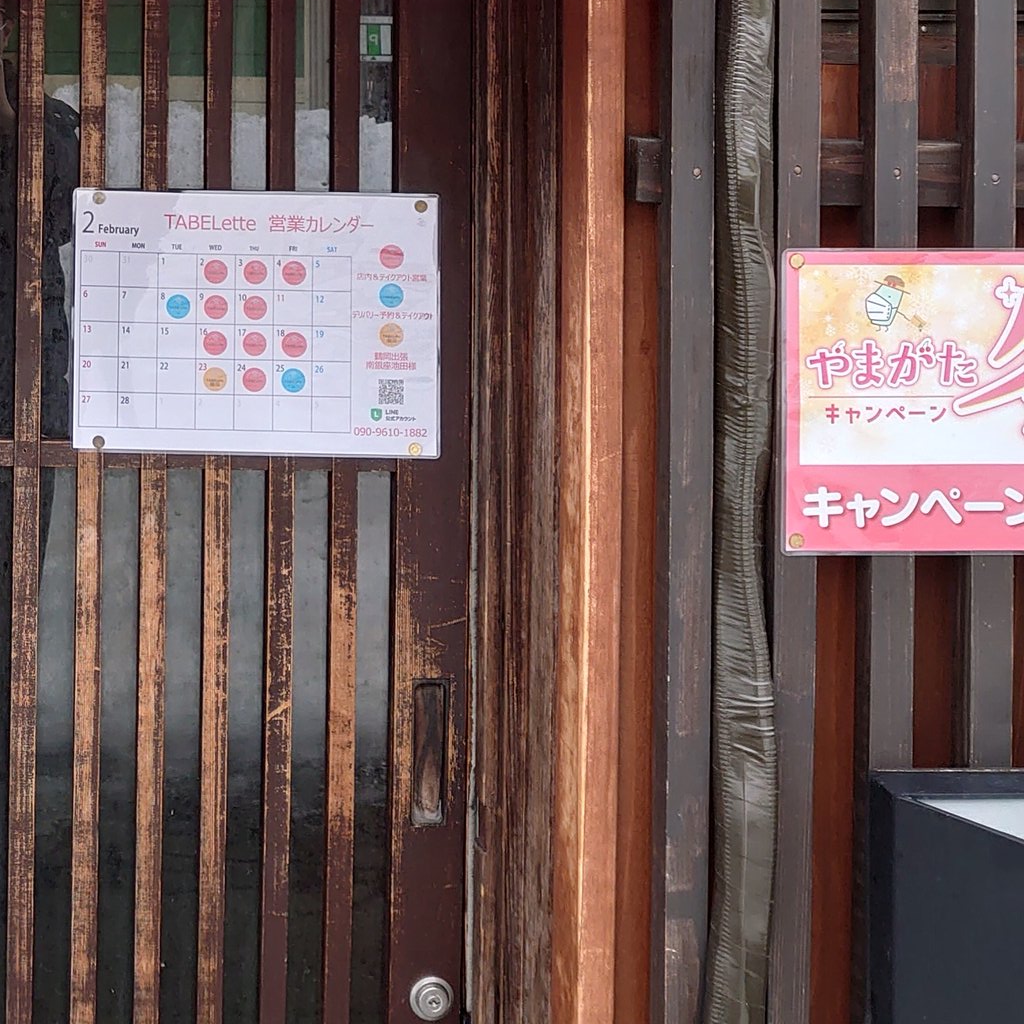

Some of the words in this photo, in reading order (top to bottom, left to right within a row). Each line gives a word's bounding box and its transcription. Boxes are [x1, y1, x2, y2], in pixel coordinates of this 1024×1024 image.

[82, 211, 94, 233] 2
[98, 224, 139, 237] February
[164, 214, 256, 231] TABELette
[269, 215, 374, 233] 営業カレンダー
[83, 325, 91, 333] 13
[122, 326, 130, 334] 14
[160, 327, 169, 335] 15
[199, 328, 208, 336] 16
[276, 329, 285, 337] 18
[315, 330, 324, 338] 19
[82, 360, 91, 368] 20
[121, 361, 129, 369] 21
[159, 362, 168, 370] 22
[198, 363, 207, 371] 23
[275, 364, 285, 372] 25
[314, 365, 324, 373] 26
[807, 339, 977, 388] やまがた
[81, 395, 91, 403] 27
[120, 396, 129, 404] 28
[825, 403, 947, 424] キャンペーン
[354, 427, 428, 438] 090-9610-1882
